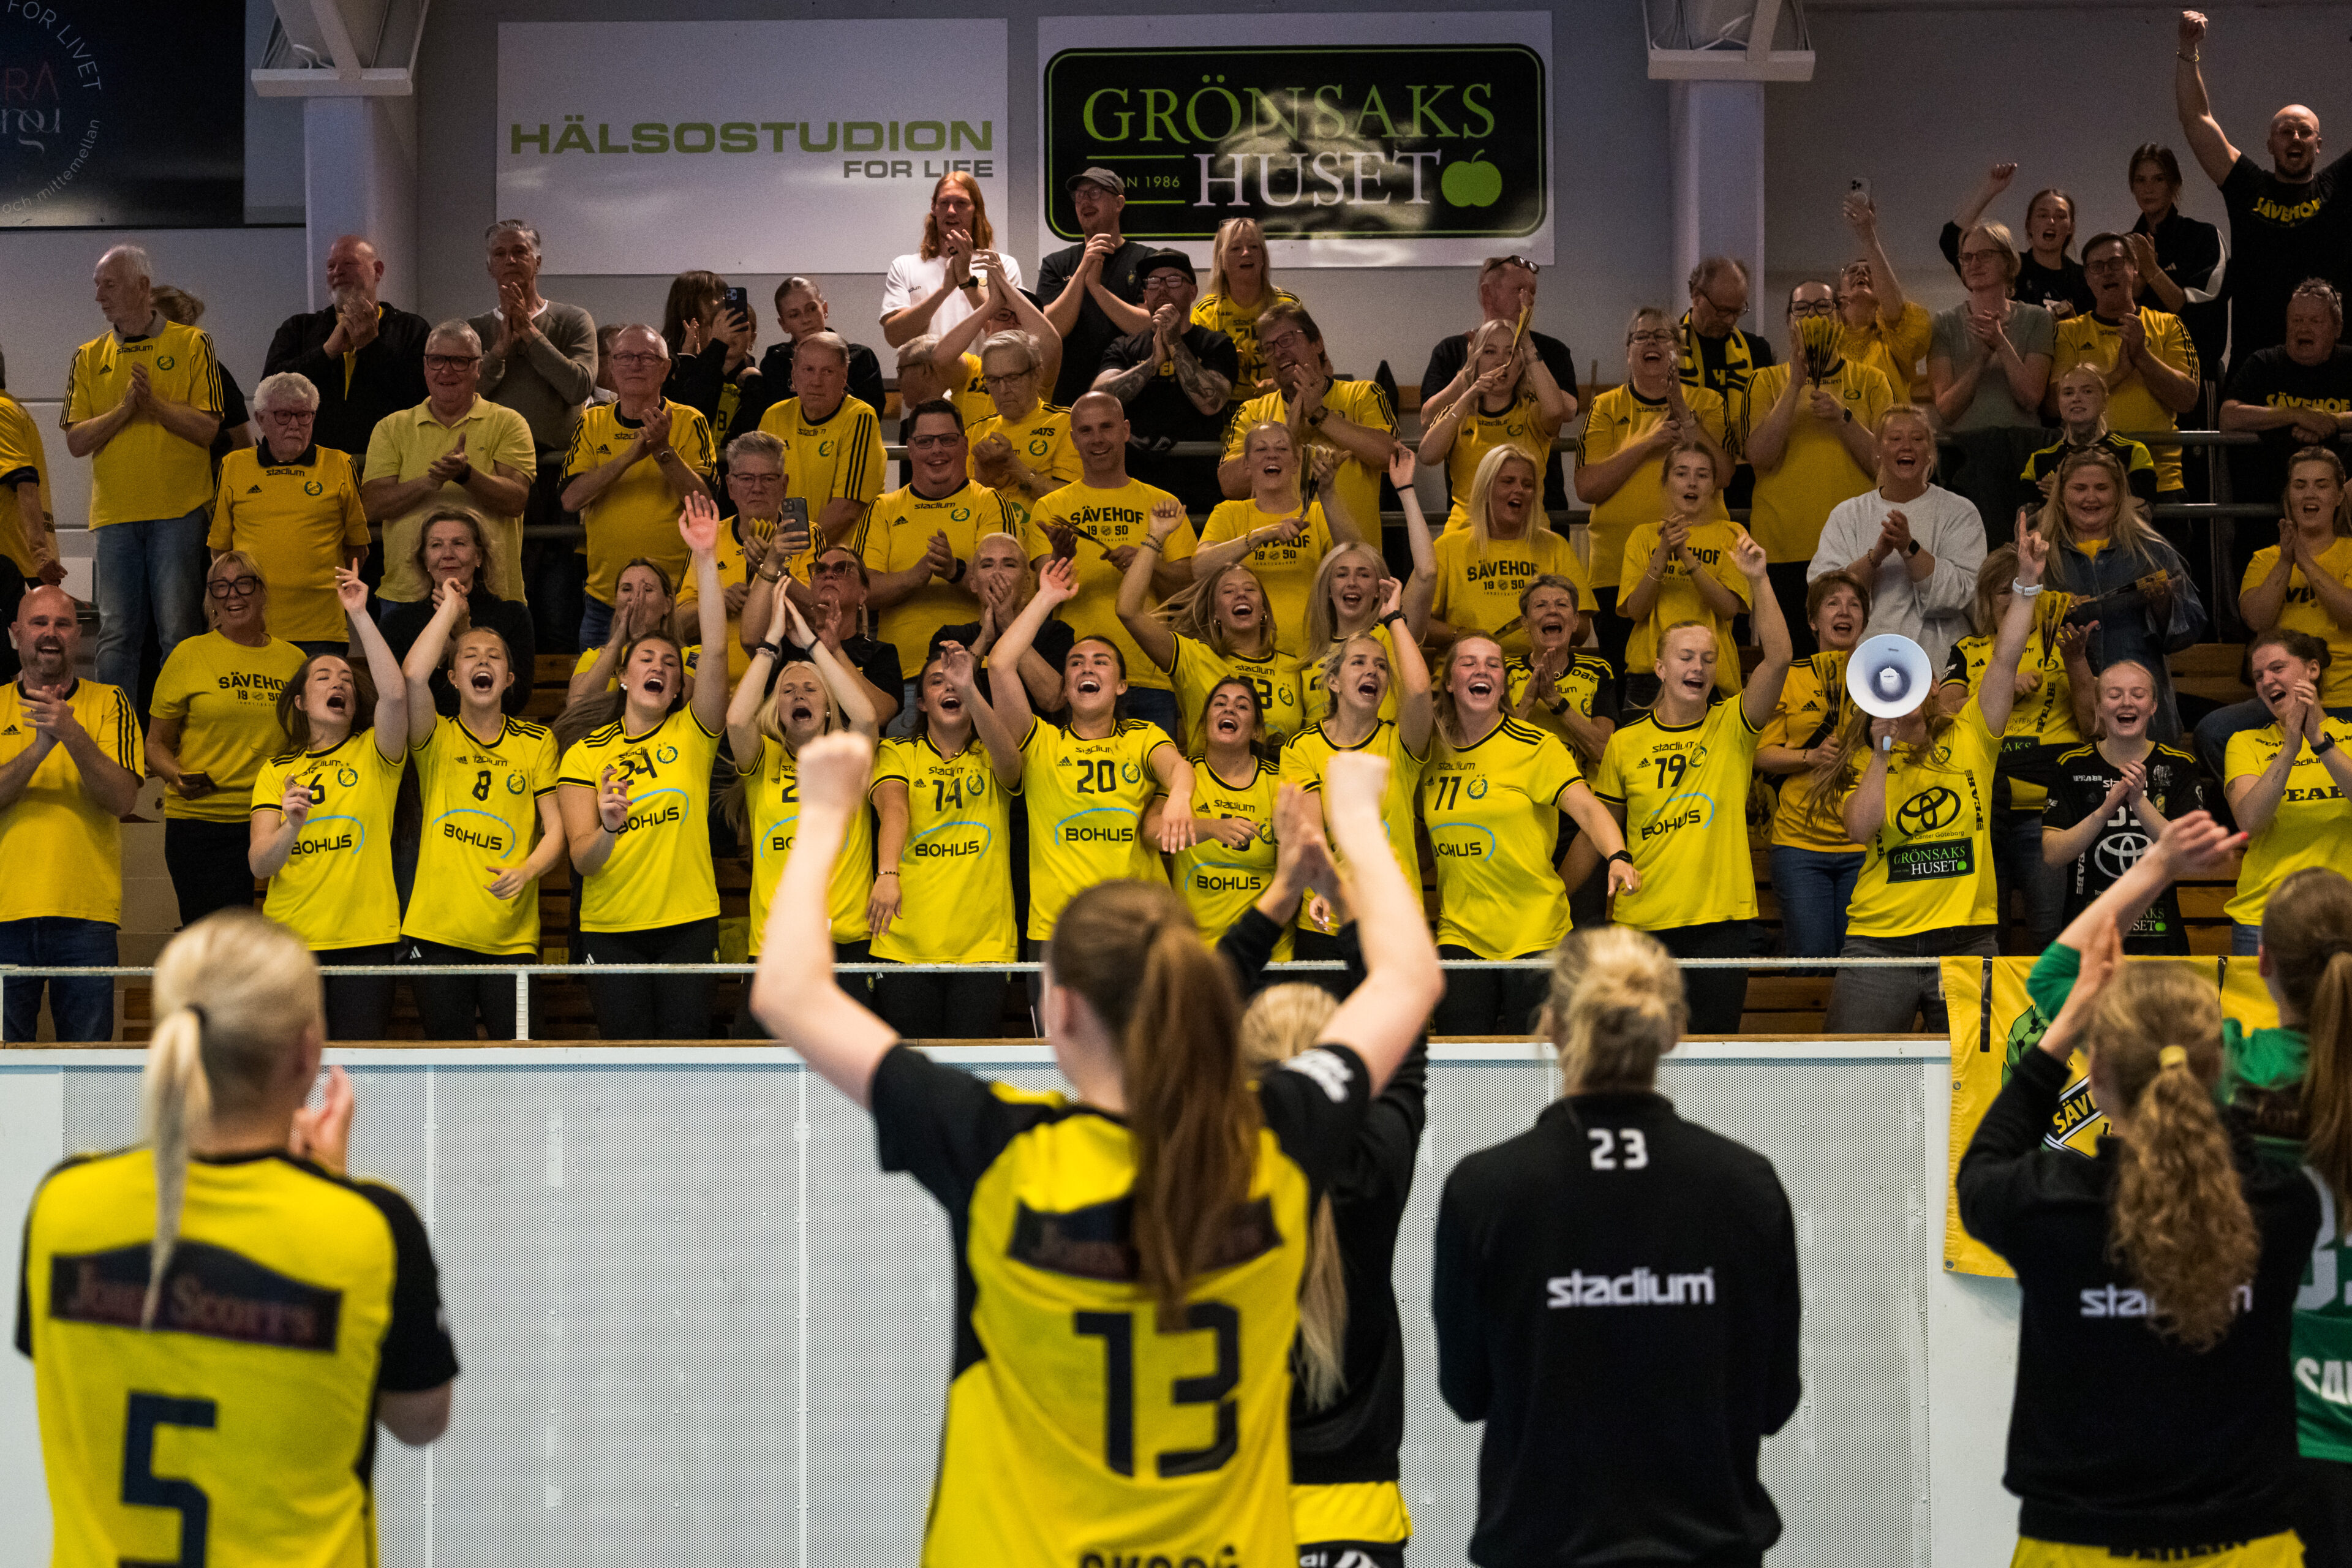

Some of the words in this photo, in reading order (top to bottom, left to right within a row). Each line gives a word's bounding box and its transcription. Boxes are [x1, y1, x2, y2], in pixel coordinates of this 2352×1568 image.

[57, 24, 101, 90] LIVET
[1082, 74, 1495, 144] GRÖNSAKS
[511, 115, 993, 154] HÄLSOSTUDION
[2, 196, 32, 214] och
[37, 119, 100, 202] mittemellan
[843, 160, 912, 178] FOR
[924, 160, 993, 178] LIFE
[1192, 148, 1441, 208] HUSET
[1144, 176, 1180, 187] 1986
[116, 345, 153, 355] stadium
[266, 467, 305, 477] stadium
[1070, 505, 1144, 526] SÄVEHOF
[1115, 525, 1128, 535] 50
[1283, 549, 1297, 559] 50
[1511, 579, 1525, 589] 50
[219, 672, 288, 691] SÄVEHO
[1235, 665, 1275, 676] stadium
[1077, 760, 1116, 794] 20
[1655, 754, 1687, 789] 19
[307, 774, 326, 805] 6
[472, 771, 491, 801] 8
[933, 777, 962, 812] 14
[1434, 776, 1462, 811] 11
[2283, 786, 2346, 802] EAB
[1213, 799, 1255, 813] stadium
[617, 807, 679, 834] BOHUS
[1642, 810, 1700, 841] BOHUS
[291, 834, 353, 855] BOHUS
[445, 823, 502, 851] BOHUS
[1066, 827, 1133, 841] BOHUS
[916, 840, 980, 857] BOHUS
[1894, 845, 1965, 865] GRÖNSAKS
[1911, 859, 1958, 875] HUSET
[1197, 875, 1261, 890] BOHUS
[1588, 1128, 1649, 1170] 23
[1546, 1266, 1715, 1310] stadium
[1073, 1302, 1239, 1477] 13
[121, 1390, 216, 1568] 5
